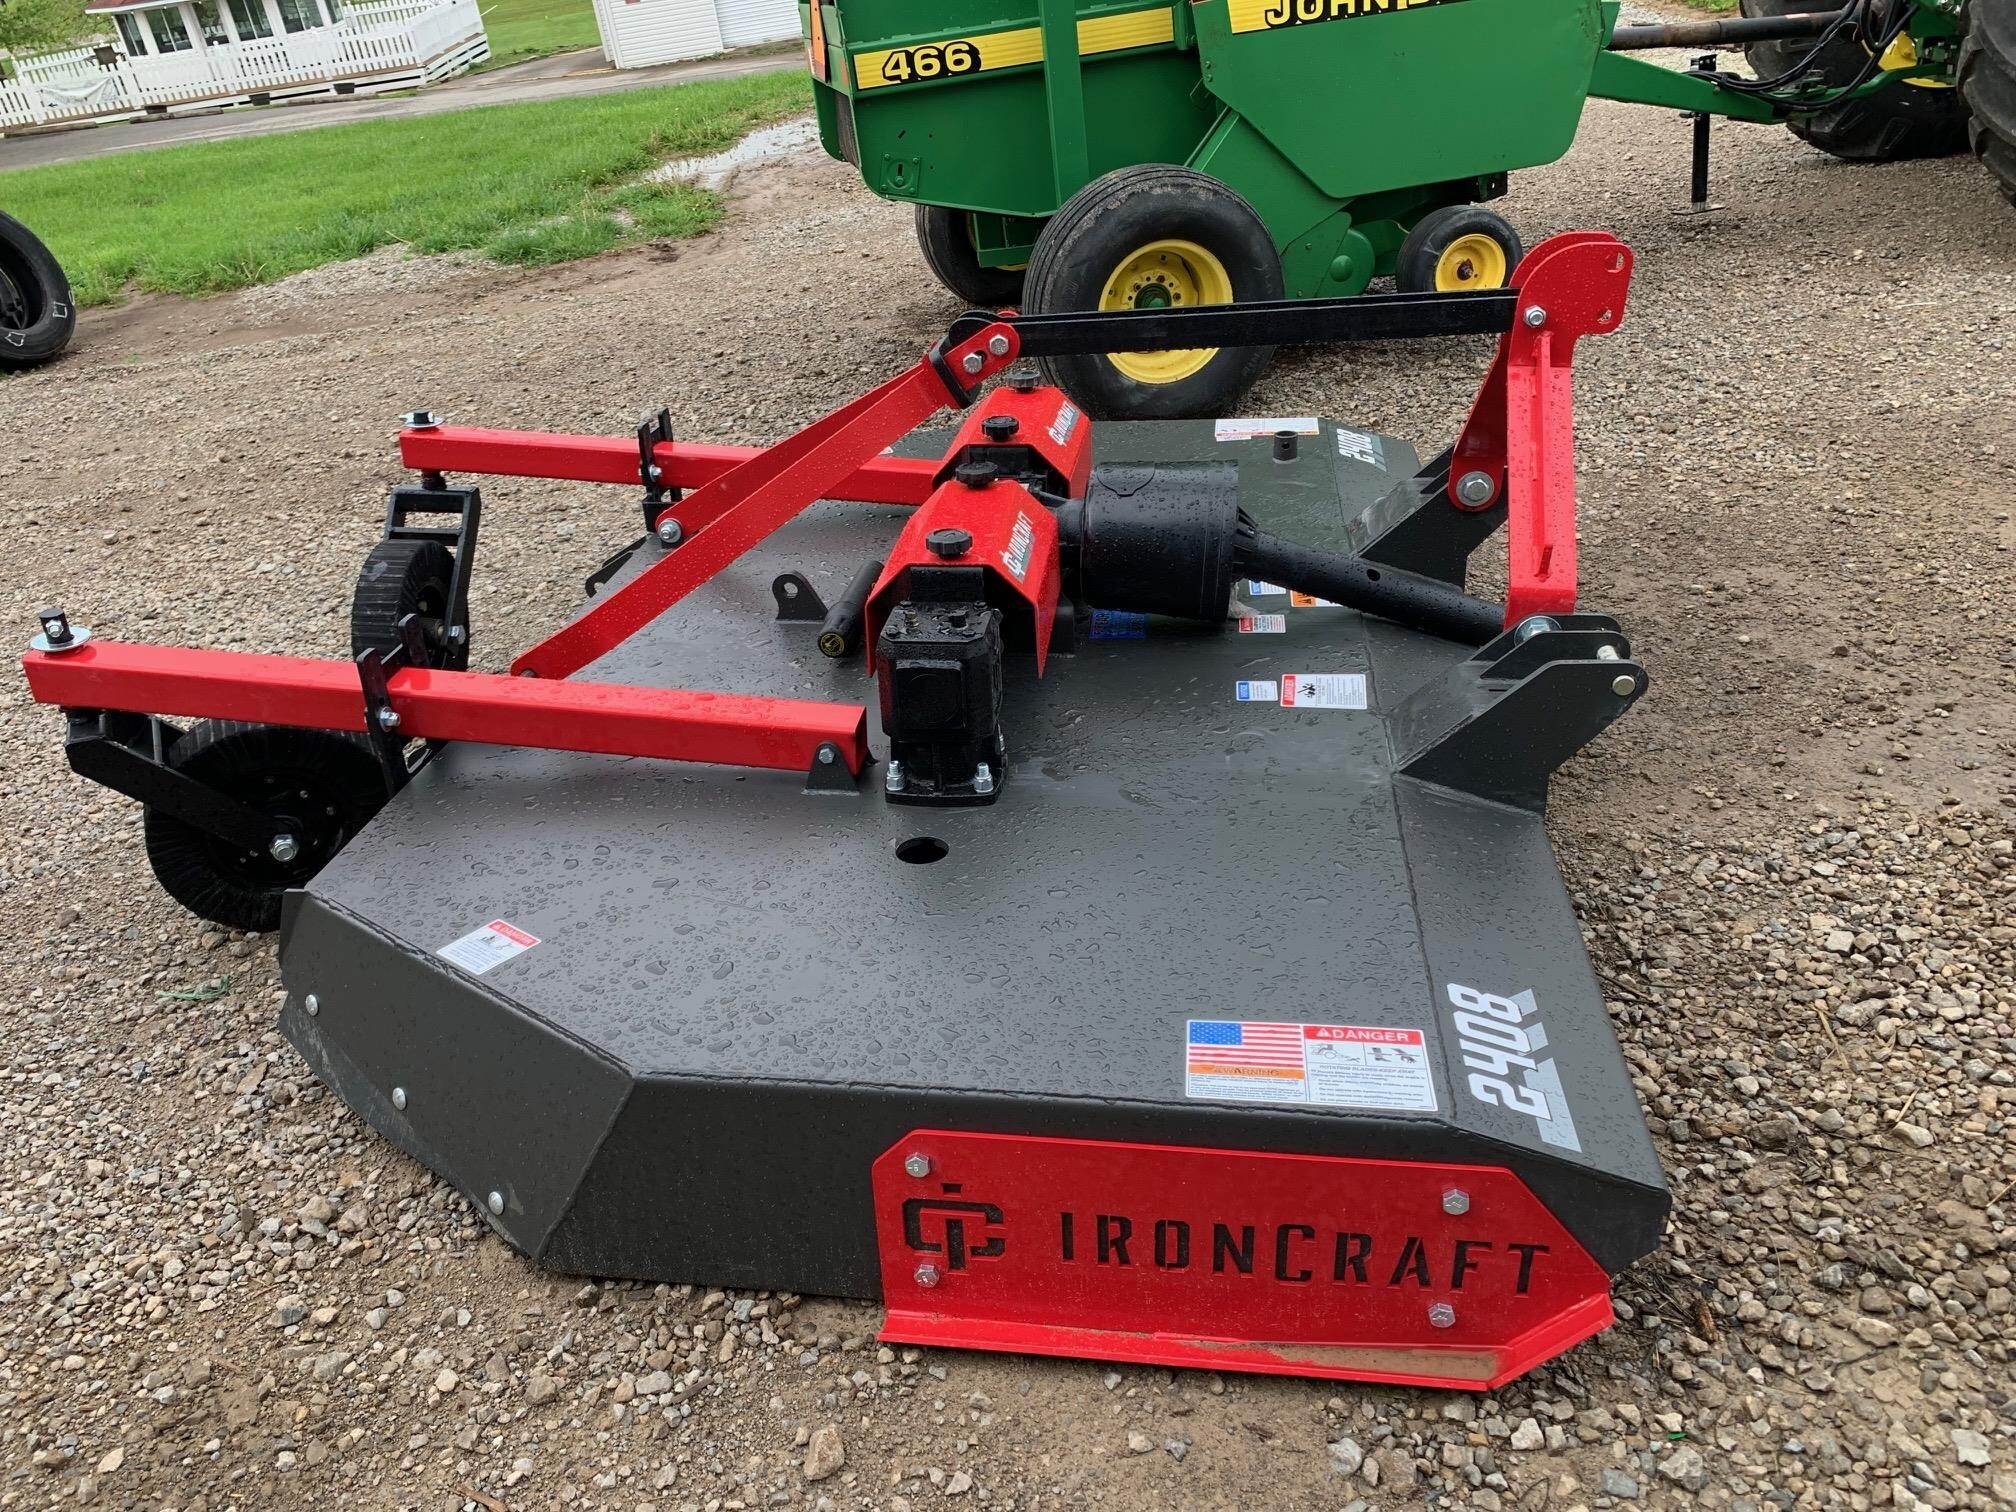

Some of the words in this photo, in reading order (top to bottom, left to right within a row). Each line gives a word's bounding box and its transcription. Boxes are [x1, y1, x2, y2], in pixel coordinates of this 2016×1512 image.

[884, 42, 974, 81] 466
[1336, 428, 1376, 465] 2408
[1008, 510, 1033, 562] IRONCRAFT
[1332, 1029, 1409, 1042] DANGER
[1446, 982, 1552, 1121] 2408
[1060, 1211, 1551, 1295] IRONCRAFT
